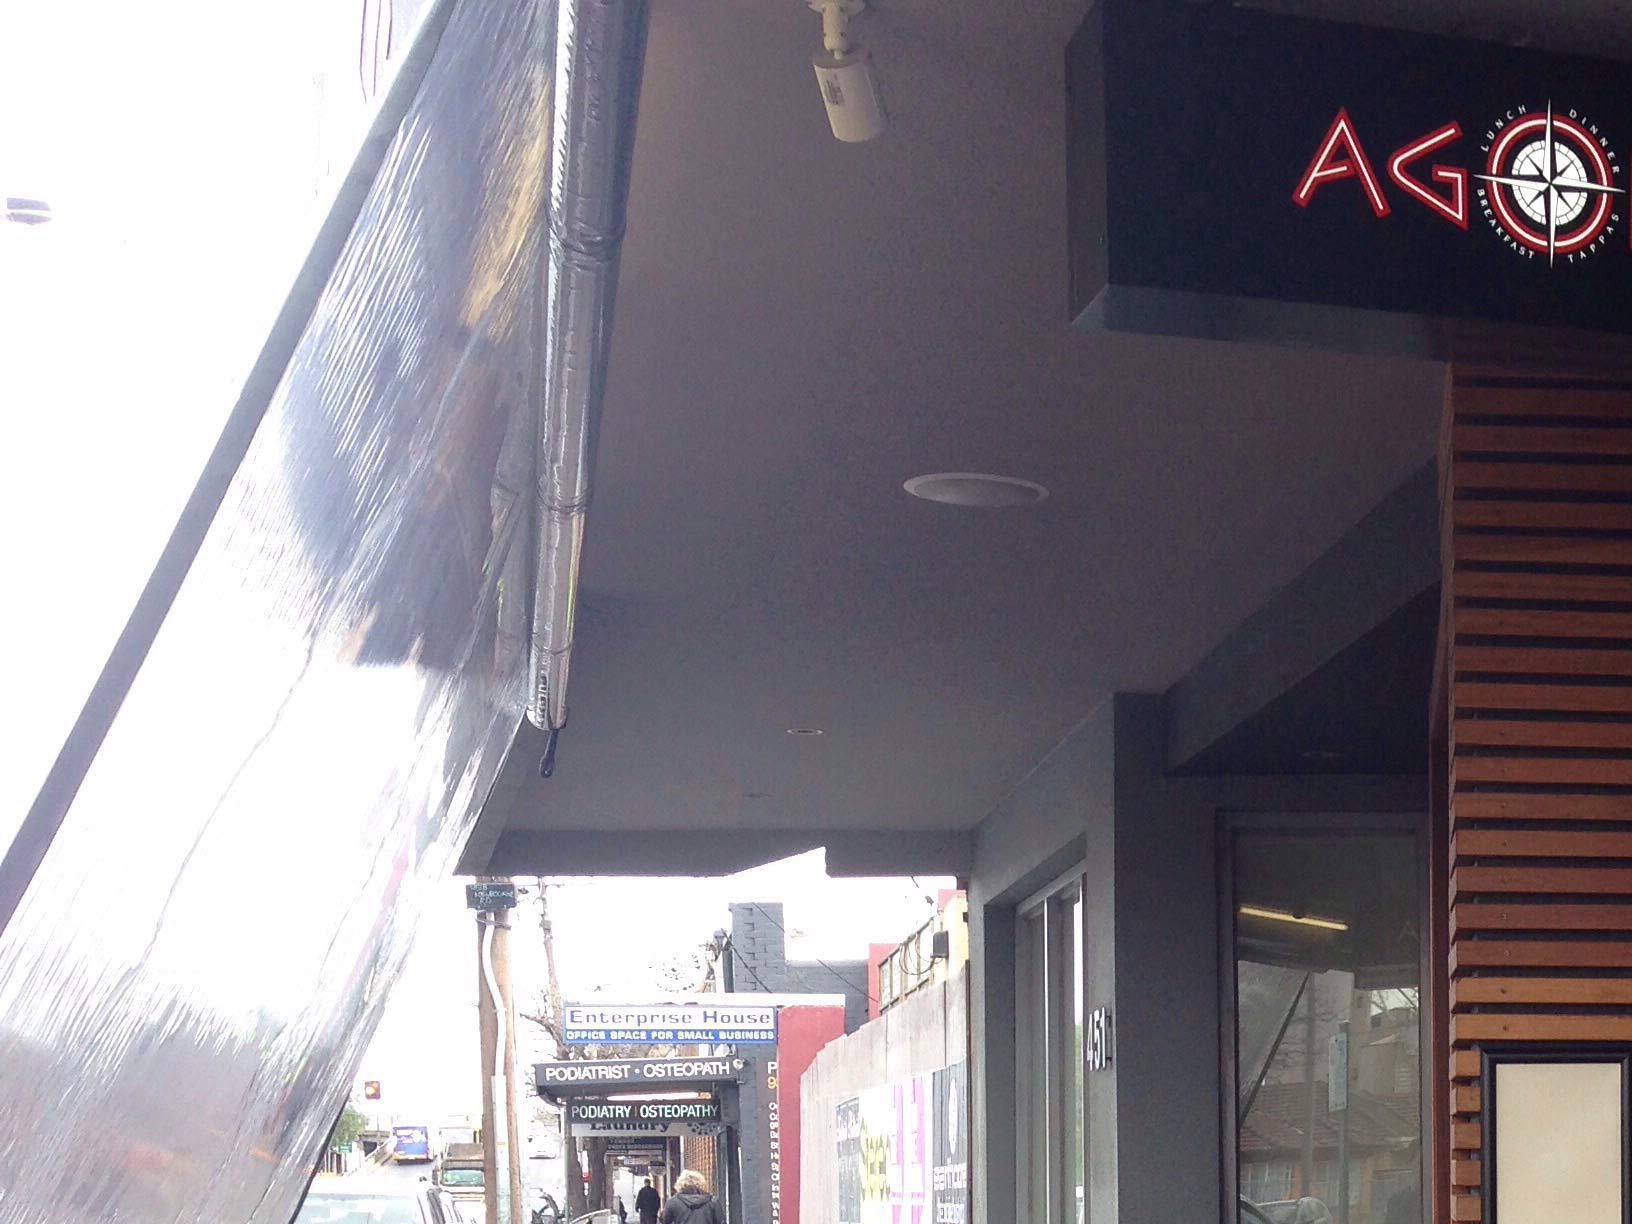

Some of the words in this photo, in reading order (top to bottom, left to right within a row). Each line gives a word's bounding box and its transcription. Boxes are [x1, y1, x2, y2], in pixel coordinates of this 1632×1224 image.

[1480, 104, 1527, 152] LUNCH
[1569, 109, 1620, 174] DINNER
[1476, 188, 1535, 259] BREAKFAST
[1567, 213, 1620, 263] TAPPAS
[566, 1030, 606, 1041] OFFICE
[610, 1030, 647, 1041] SPACE
[651, 1030, 674, 1041] FOR
[677, 1030, 715, 1041] SMALL
[718, 1030, 775, 1041] BUSINESS
[569, 1010, 693, 1027] Enterprise
[703, 1010, 771, 1025] House
[1086, 1006, 1106, 1072] 451
[545, 1064, 631, 1082] PODIATRIST
[643, 1061, 730, 1078] OSTEOPATH
[571, 1105, 632, 1119] PODIATRY
[639, 1105, 718, 1119] OSTEOPATHY
